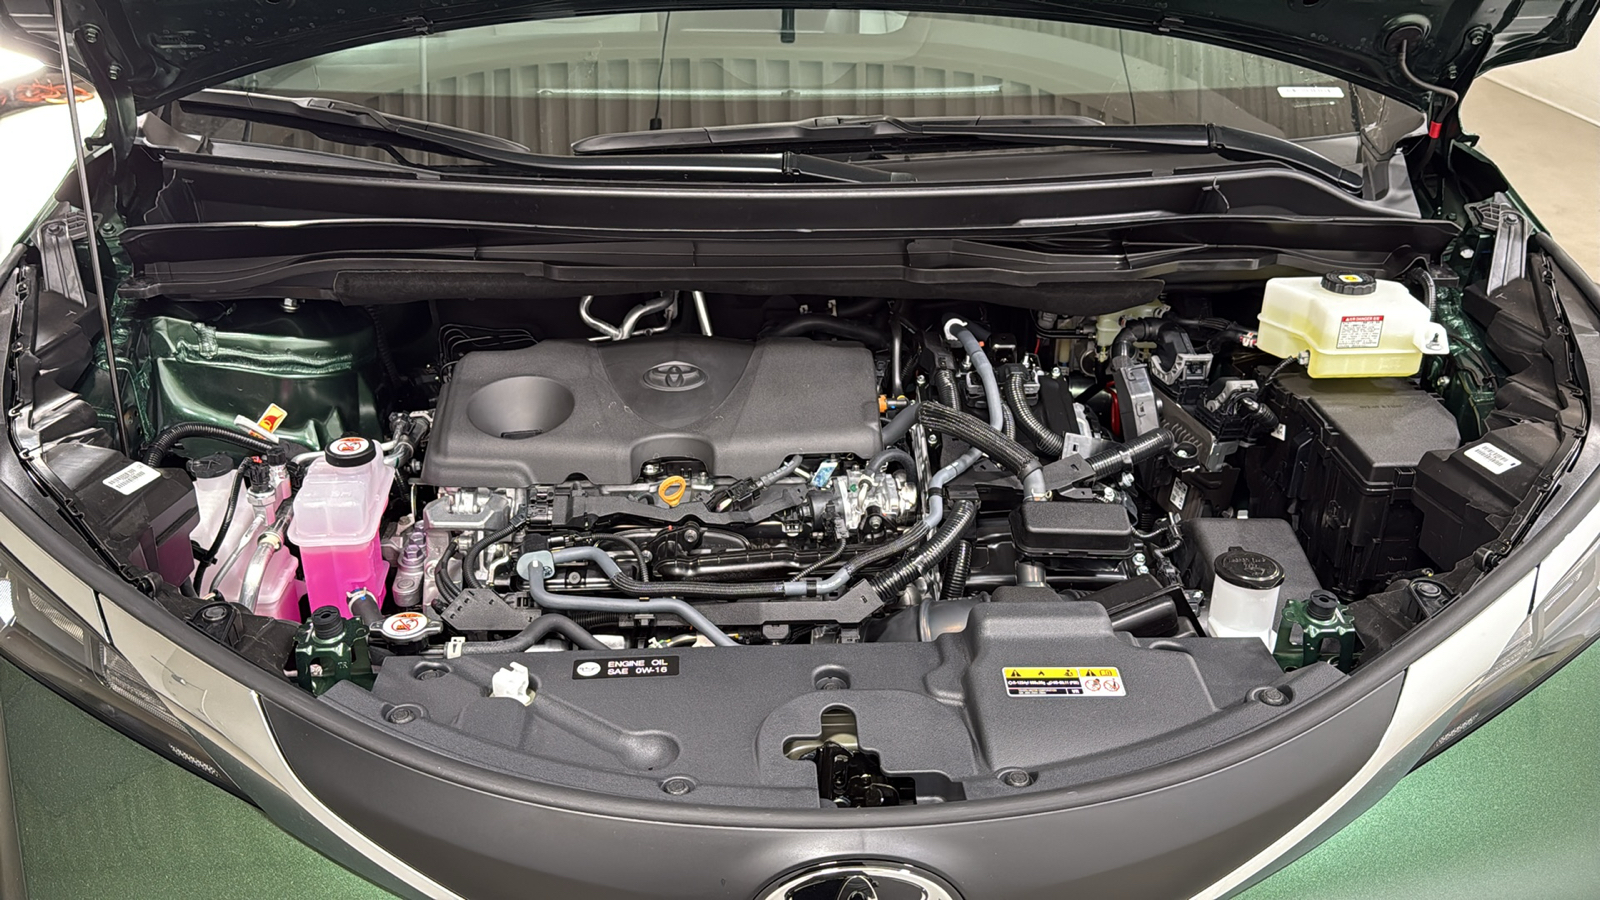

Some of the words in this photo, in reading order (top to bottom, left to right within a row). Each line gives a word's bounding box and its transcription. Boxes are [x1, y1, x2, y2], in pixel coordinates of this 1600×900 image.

[607, 660, 645, 668] ENGINE
[607, 667, 629, 676] SAE
[635, 666, 668, 675] 0W-16
